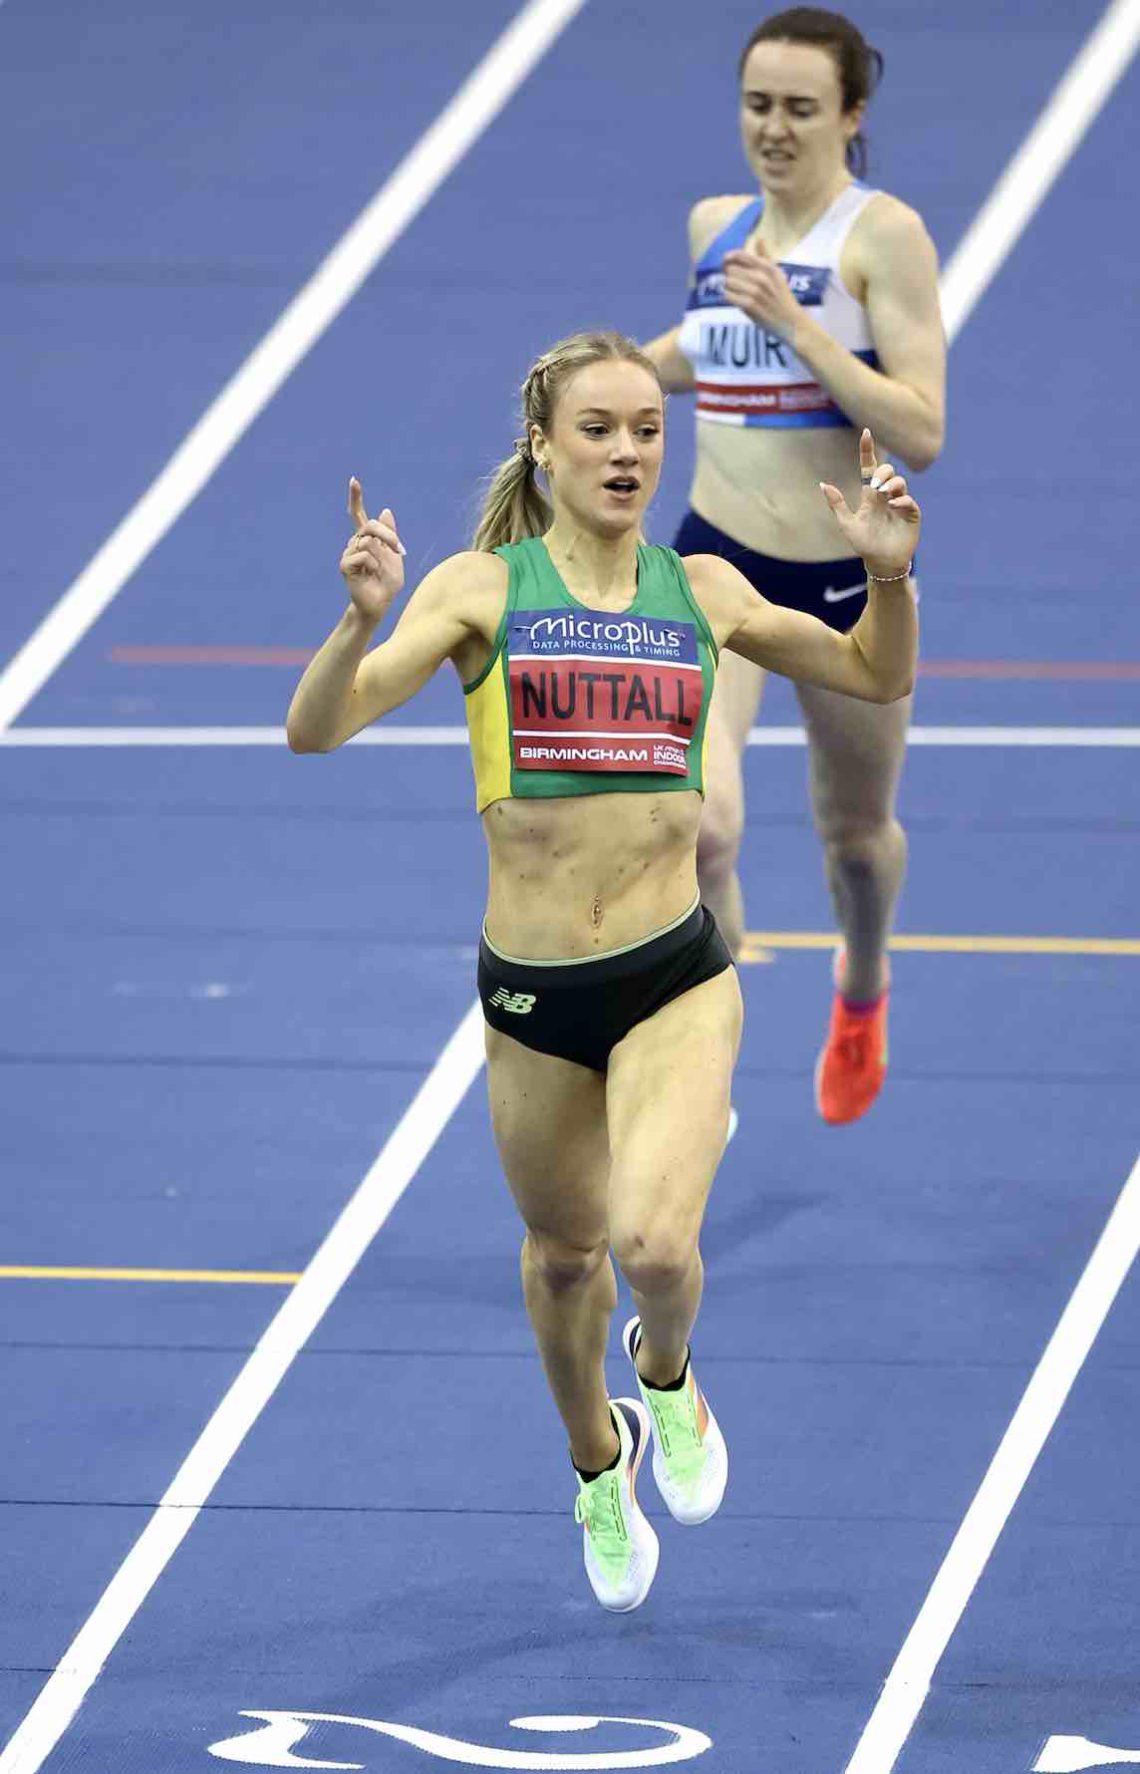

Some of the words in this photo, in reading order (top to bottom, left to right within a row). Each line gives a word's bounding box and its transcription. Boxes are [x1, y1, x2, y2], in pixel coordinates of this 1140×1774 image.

[708, 325, 787, 369] MUIR
[532, 640, 560, 650] DATA
[564, 640, 629, 651] PROCESSING
[644, 646, 681, 657] TIMING
[521, 671, 693, 727] NUTTALL
[520, 747, 648, 761] BIRMINGHAM
